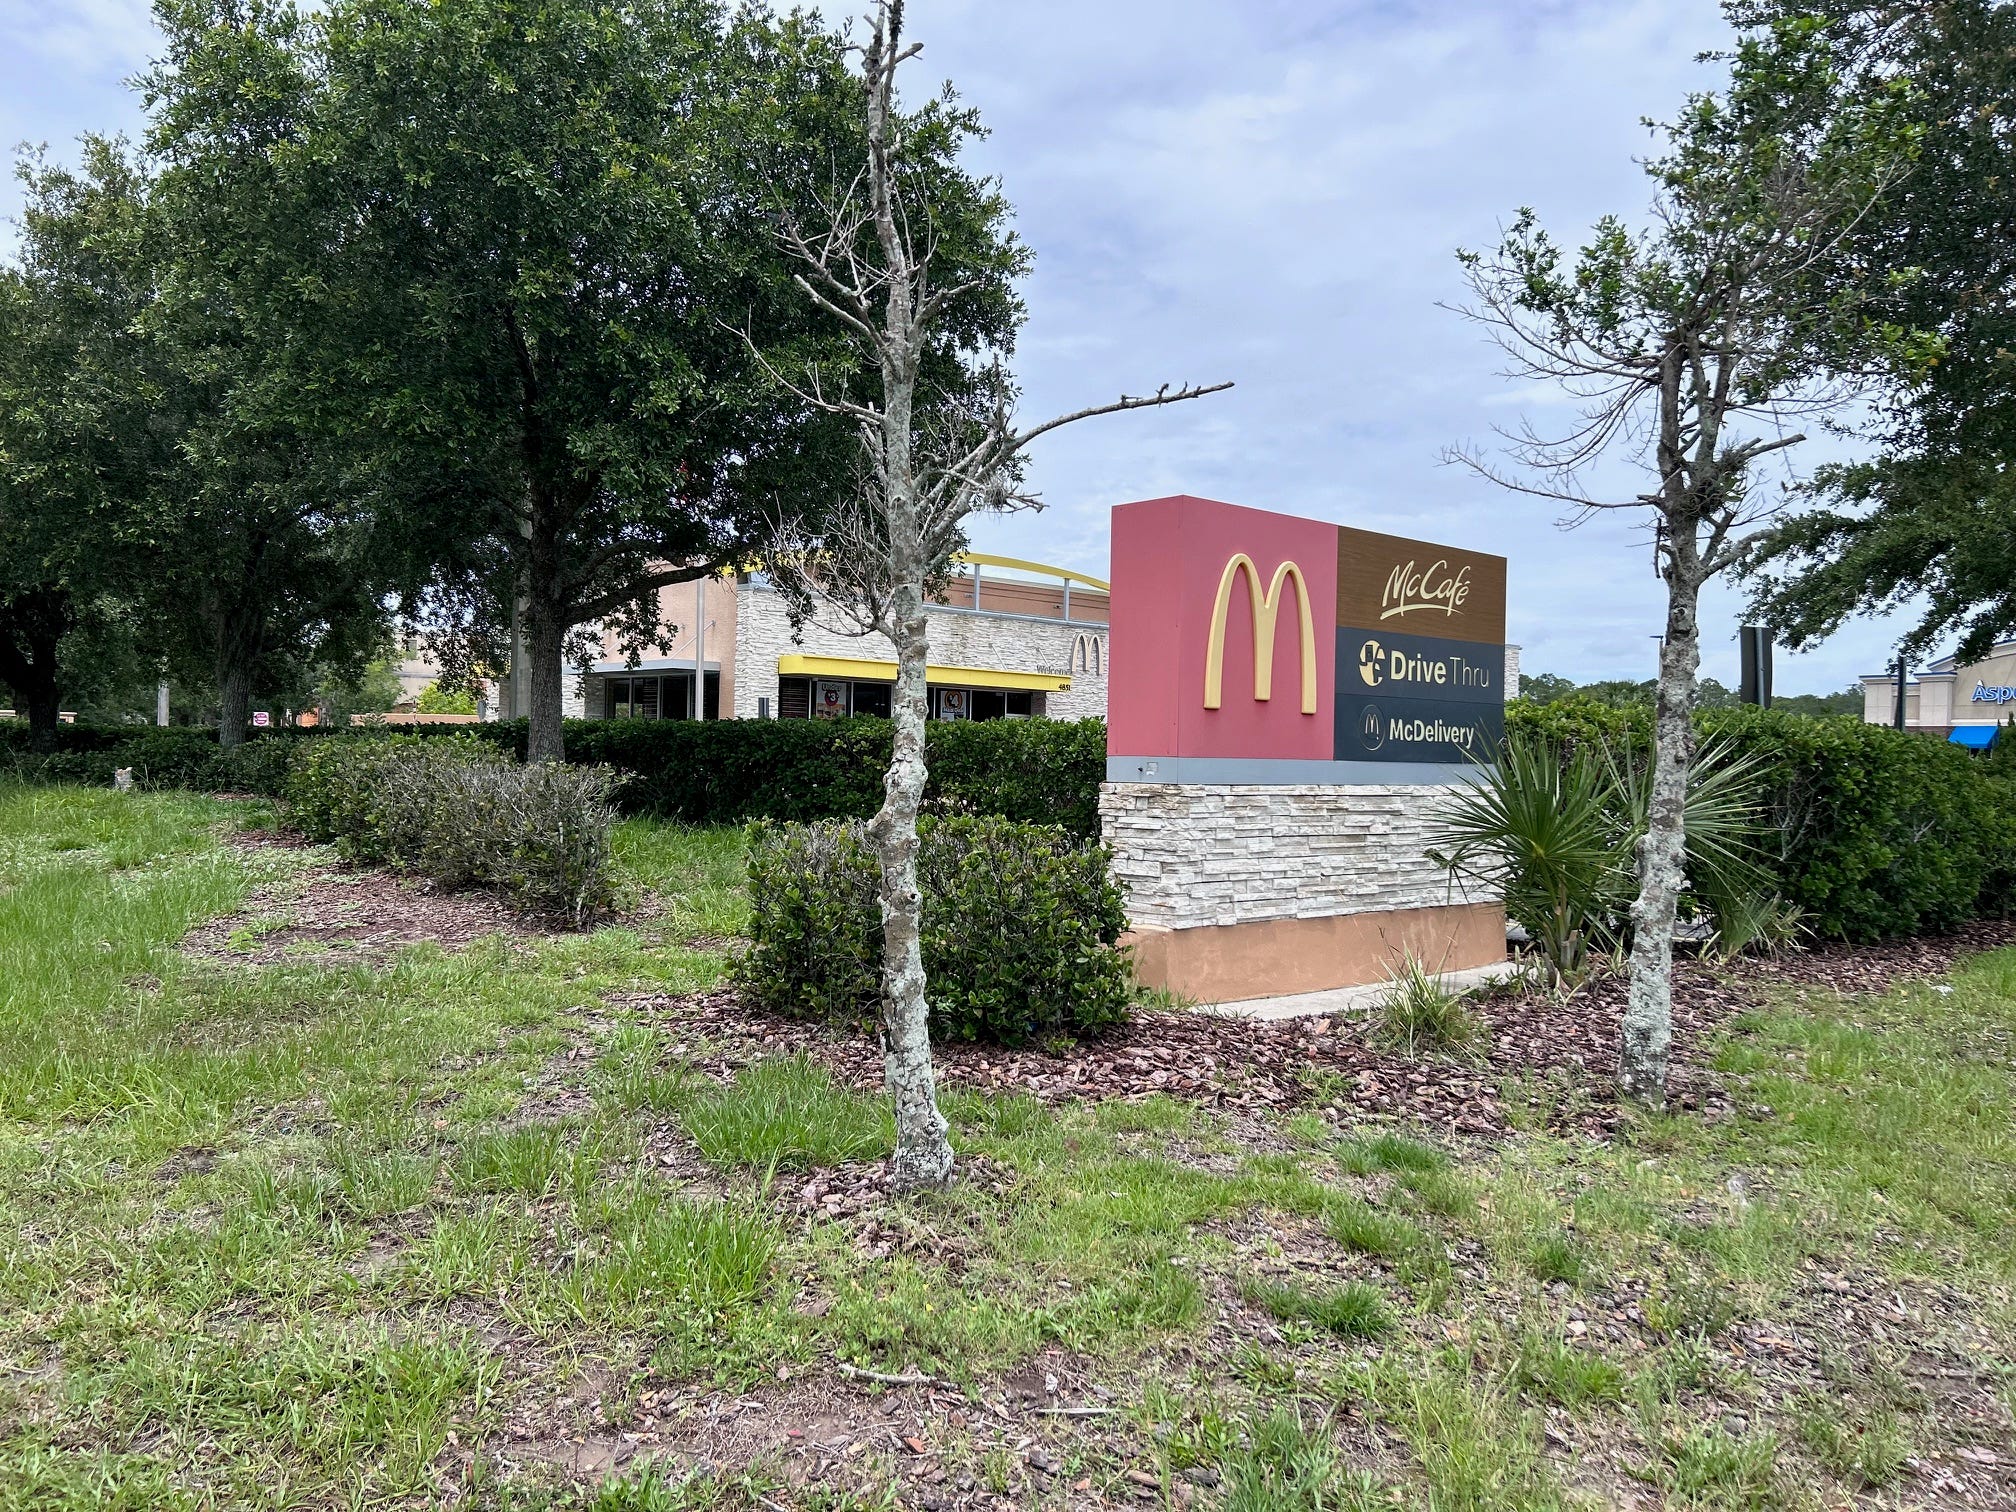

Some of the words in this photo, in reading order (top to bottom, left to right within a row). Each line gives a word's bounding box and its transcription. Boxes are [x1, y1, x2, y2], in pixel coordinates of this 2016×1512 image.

[1381, 559, 1471, 617] McCafé
[1391, 650, 1446, 684] Drive
[1450, 656, 1489, 688] Thru
[1971, 679, 2016, 705] Asp
[1389, 718, 1475, 750] McDelivery
